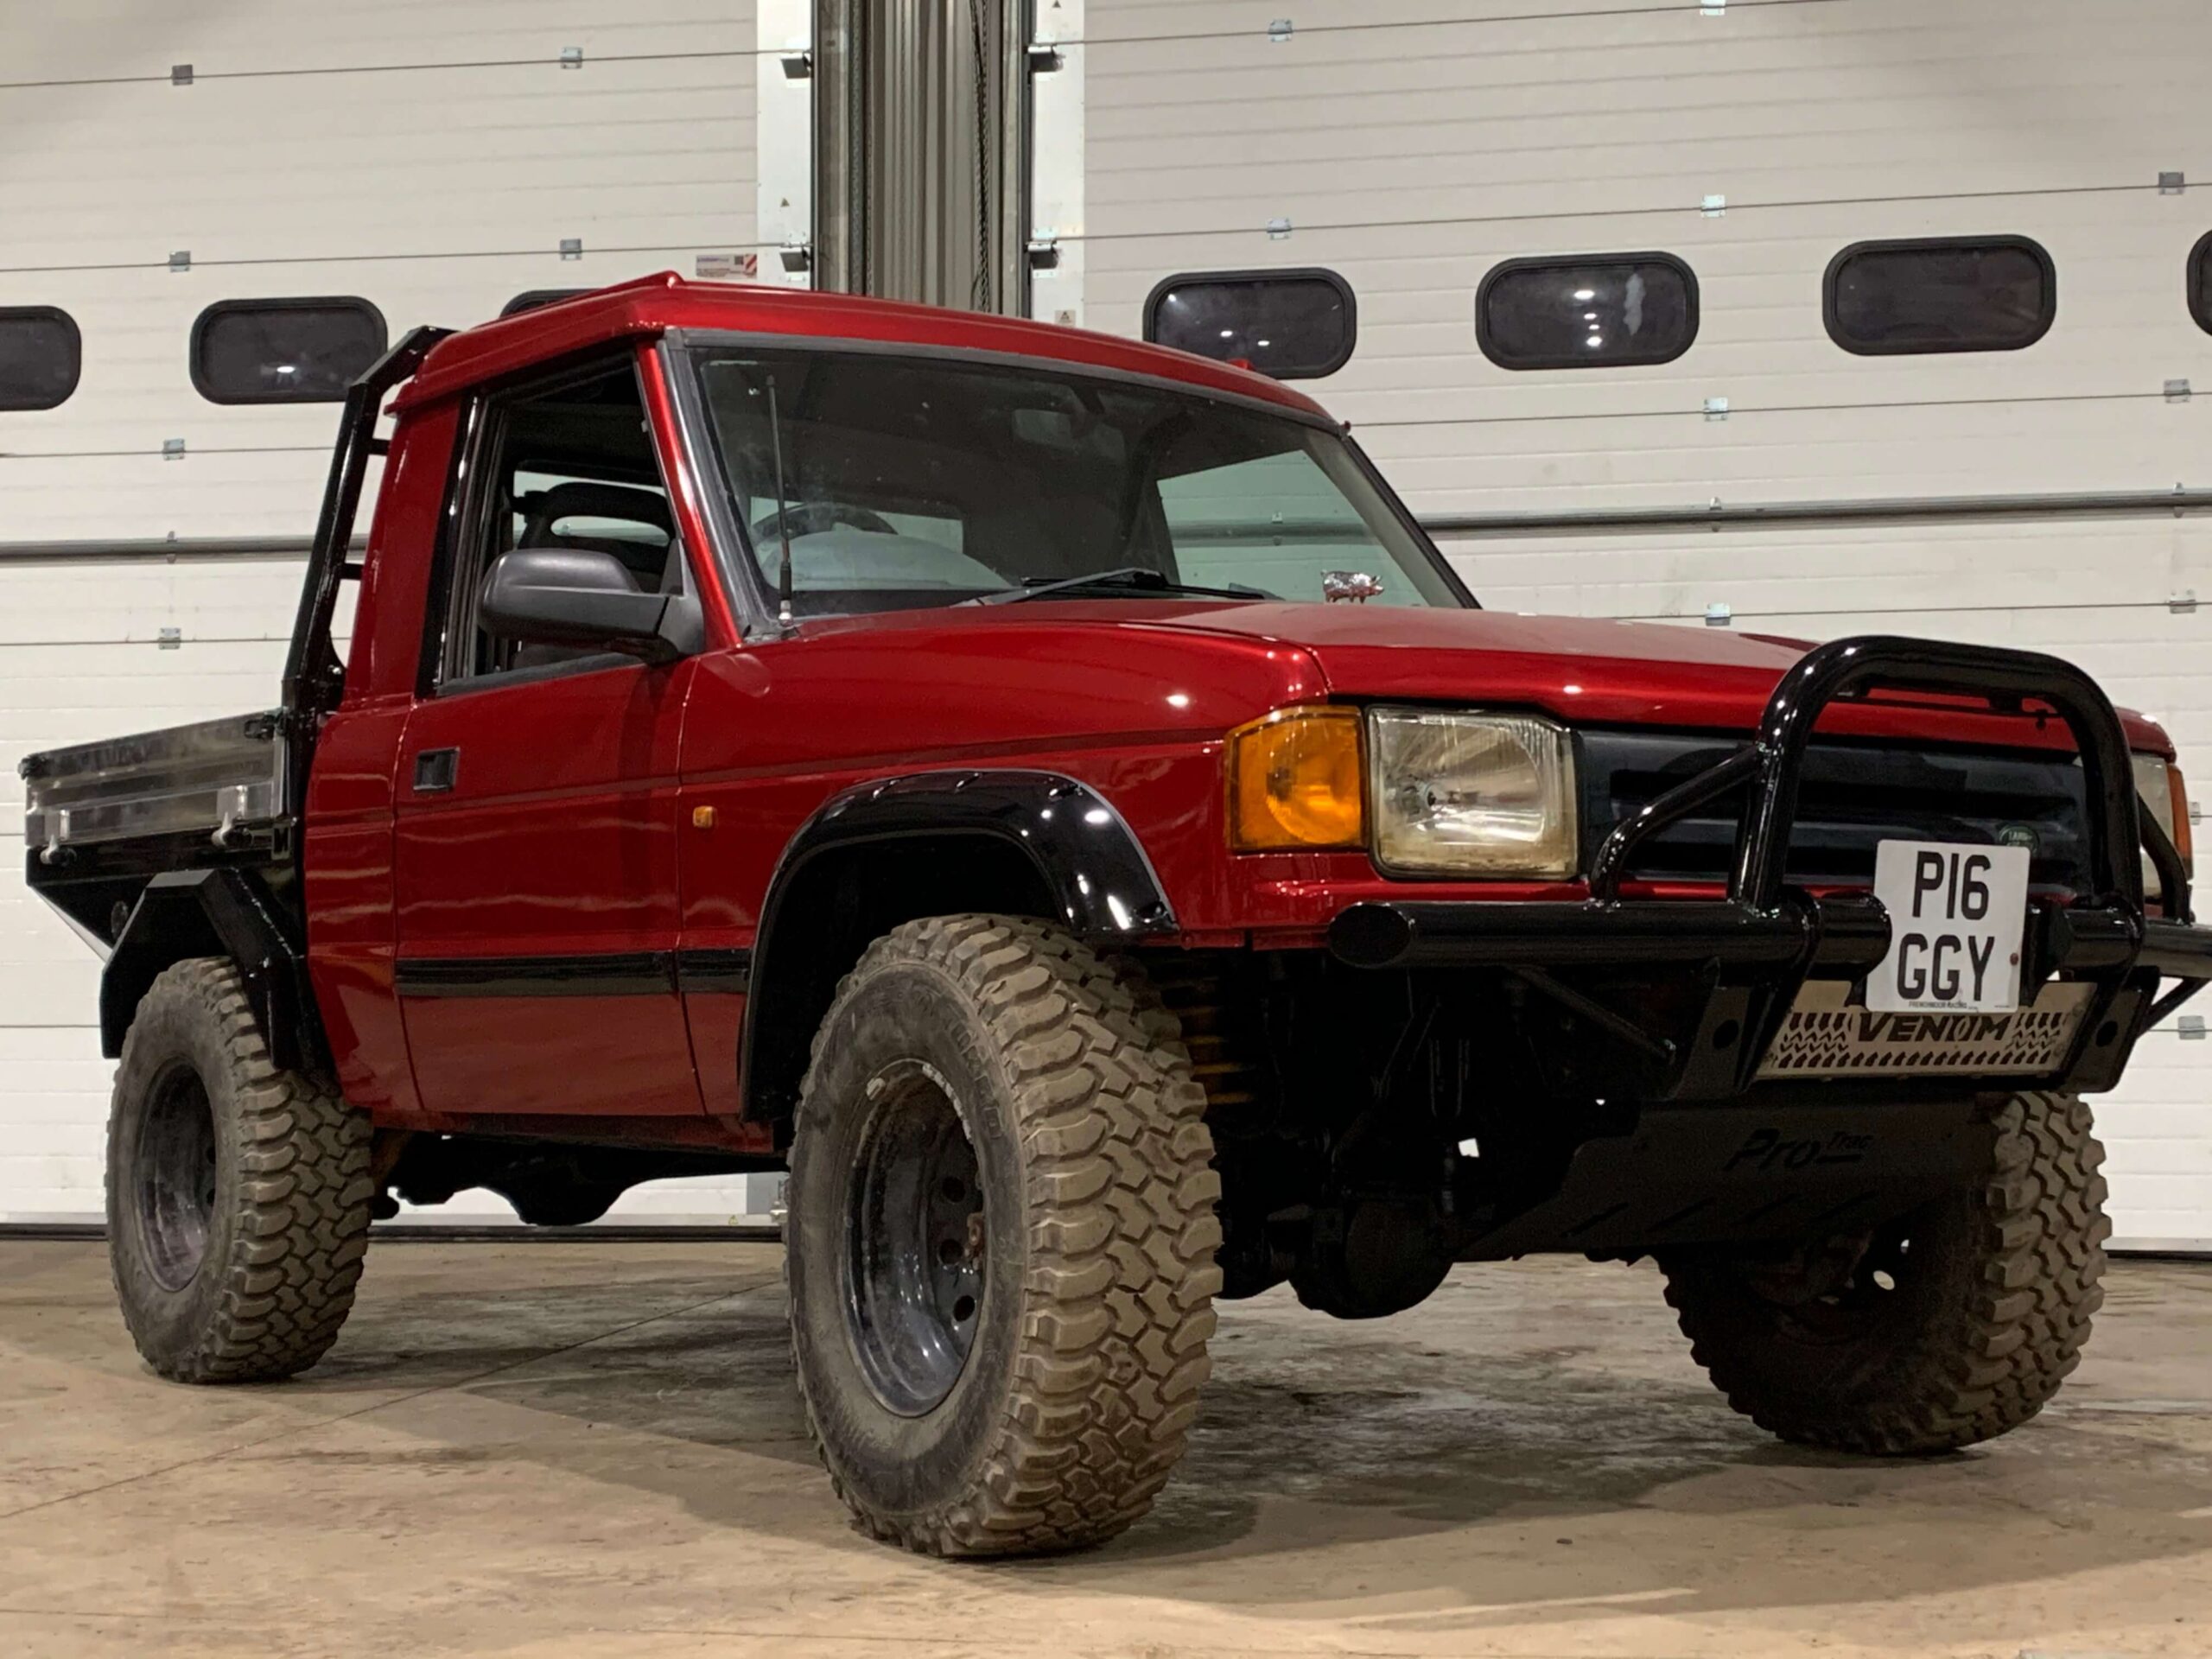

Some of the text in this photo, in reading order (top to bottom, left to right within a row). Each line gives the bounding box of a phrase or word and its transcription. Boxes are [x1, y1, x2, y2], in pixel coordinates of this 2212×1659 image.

[1912, 850, 1991, 920] P16
[1897, 932, 1995, 1001] GGY
[1857, 1013, 2012, 1042] VENOM
[1722, 1127, 1821, 1173] Pro
